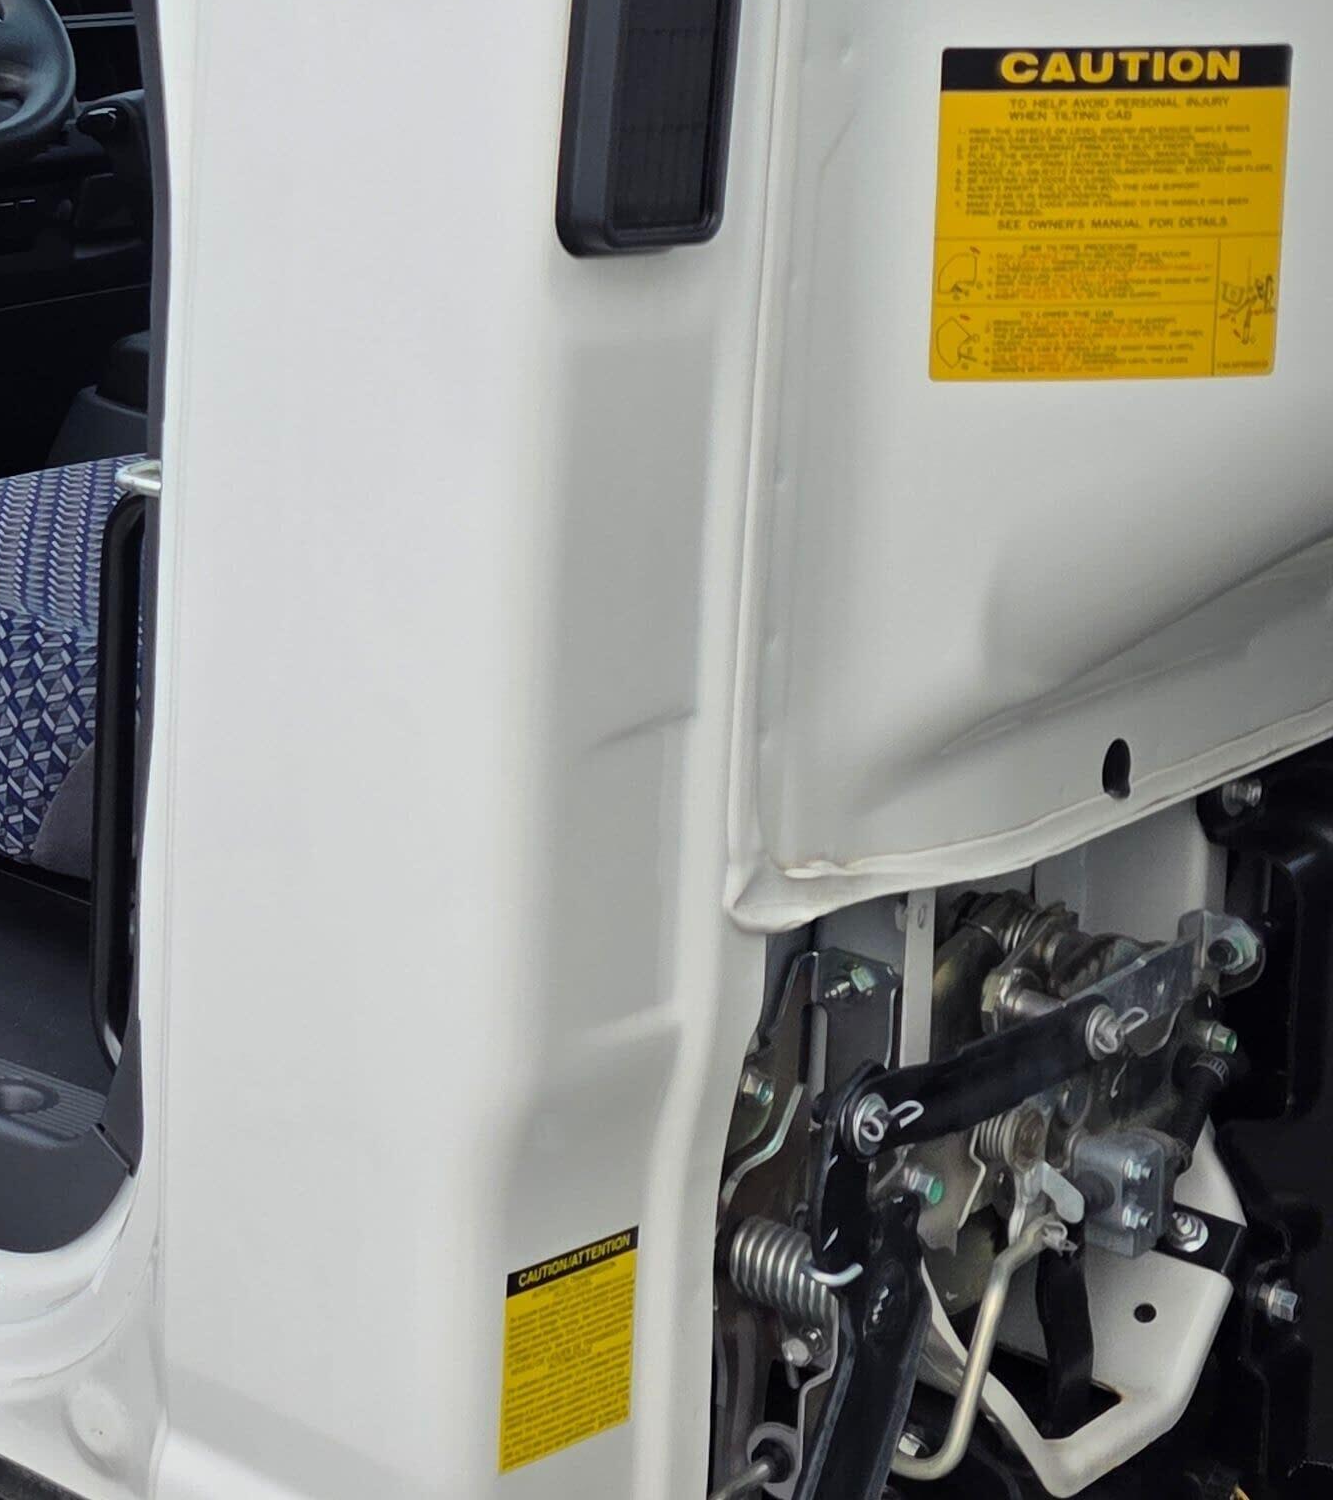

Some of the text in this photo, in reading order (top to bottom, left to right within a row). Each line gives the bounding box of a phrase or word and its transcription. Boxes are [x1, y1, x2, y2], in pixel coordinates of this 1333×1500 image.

[1000, 50, 1240, 84] CAUTION
[1010, 96, 1230, 109] TO HELP AVOID PERSONAL INJURY
[1009, 110, 1132, 121] WHEN TILTING CAB
[997, 216, 1228, 230] SEE OWNER'S MANUAL FOR DETAILS
[518, 1233, 631, 1287] CAUTION/ATTENTION
